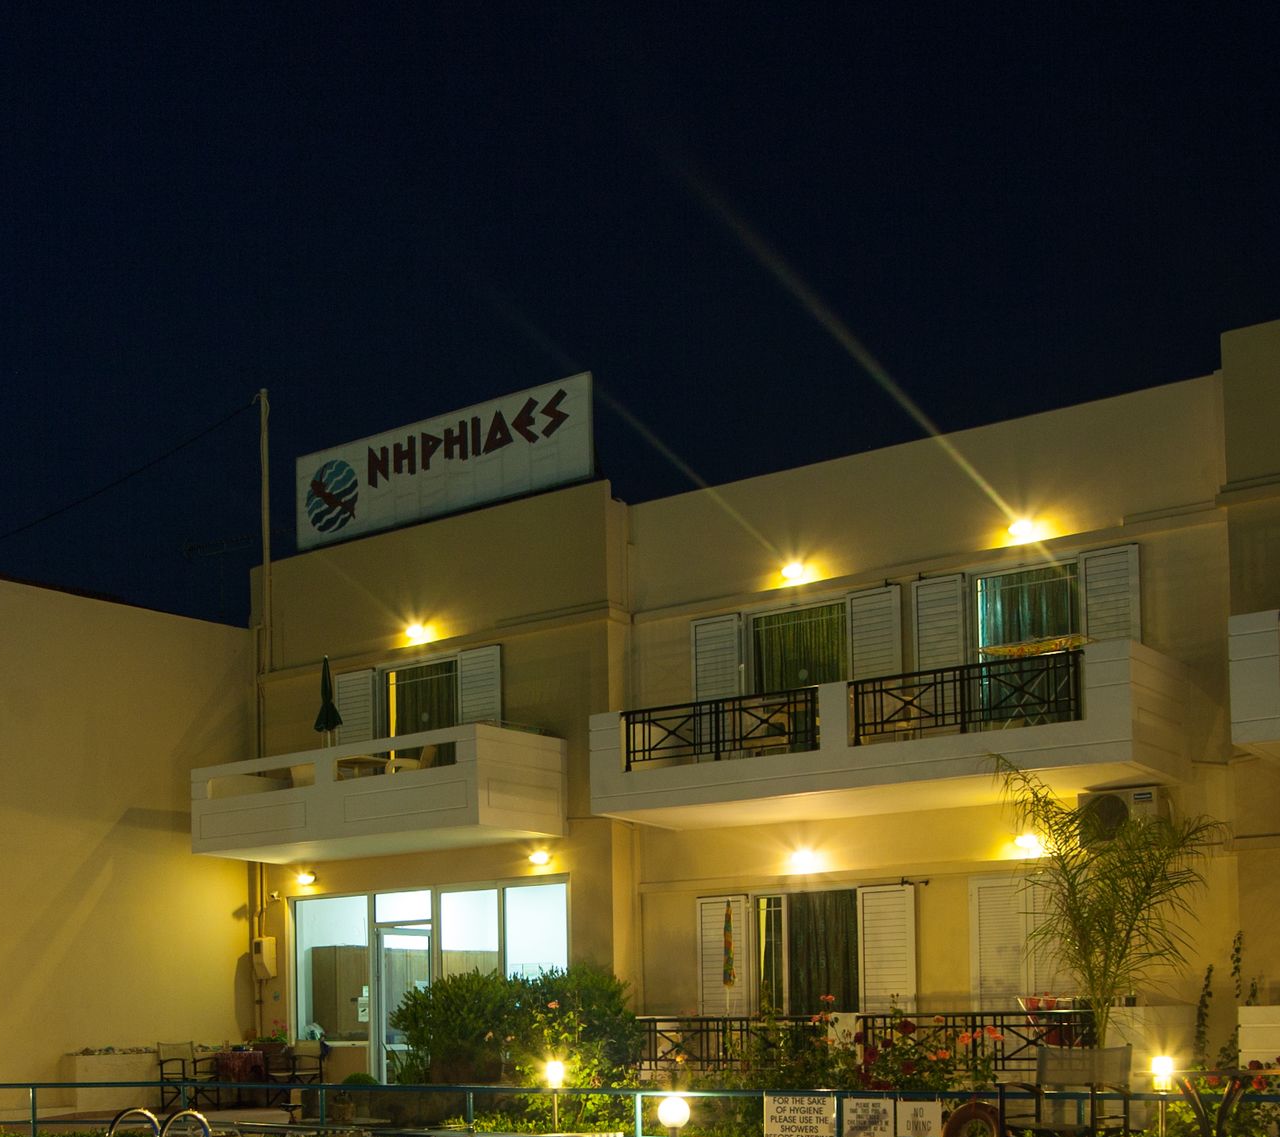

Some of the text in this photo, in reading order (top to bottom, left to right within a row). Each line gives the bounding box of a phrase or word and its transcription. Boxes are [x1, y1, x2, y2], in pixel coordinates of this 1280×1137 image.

[773, 1097, 826, 1106] FOR THE SAKE
[776, 1106, 823, 1115] OF HYGIENE
[913, 1107, 924, 1118] NO
[770, 1115, 829, 1124] PLEASE USE THE
[780, 1125, 819, 1133] SHOWERS
[906, 1120, 932, 1132] DIVING
